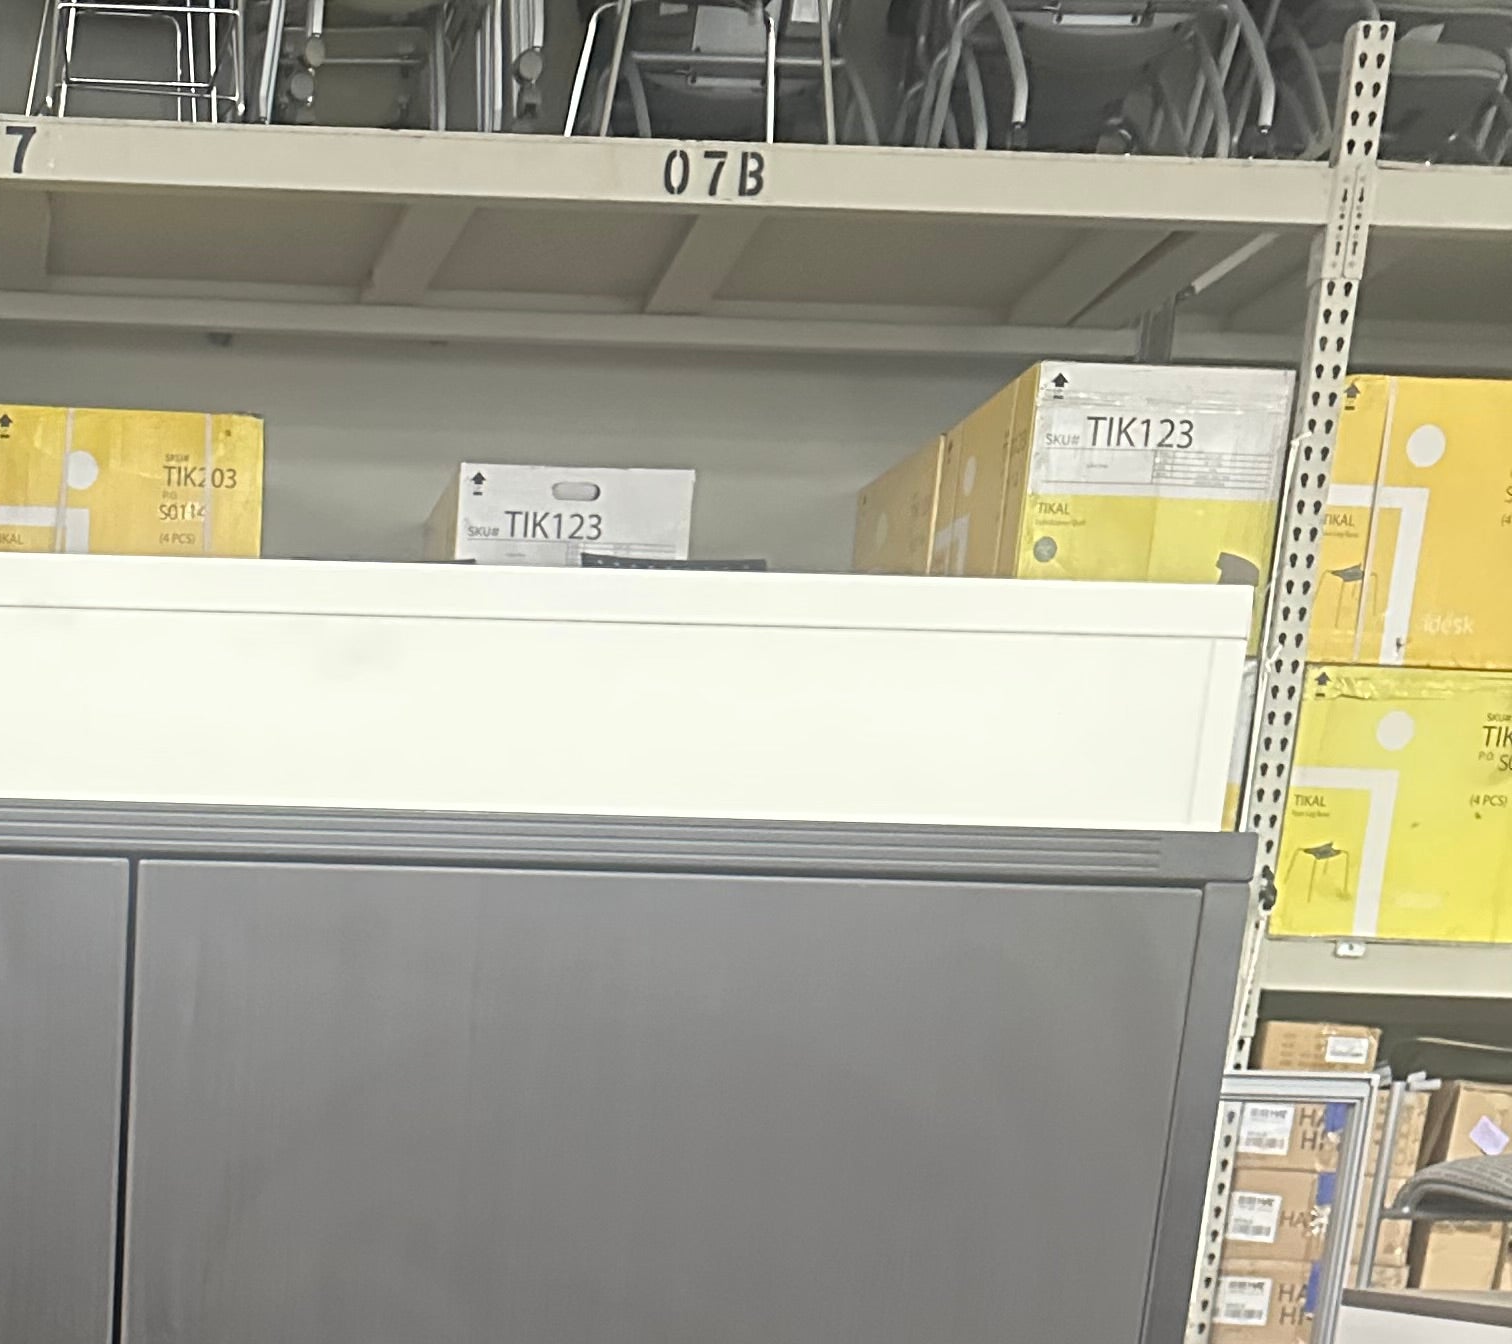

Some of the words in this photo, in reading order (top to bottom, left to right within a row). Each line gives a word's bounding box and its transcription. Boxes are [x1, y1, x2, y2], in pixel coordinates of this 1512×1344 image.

[5, 125, 37, 173] 7
[664, 149, 765, 196] 07B
[1088, 416, 1194, 449] TIK123
[163, 465, 237, 489] TIK203
[1037, 502, 1070, 515] TIKAL
[504, 510, 603, 540] TIK123
[1294, 794, 1326, 807] TIKAL
